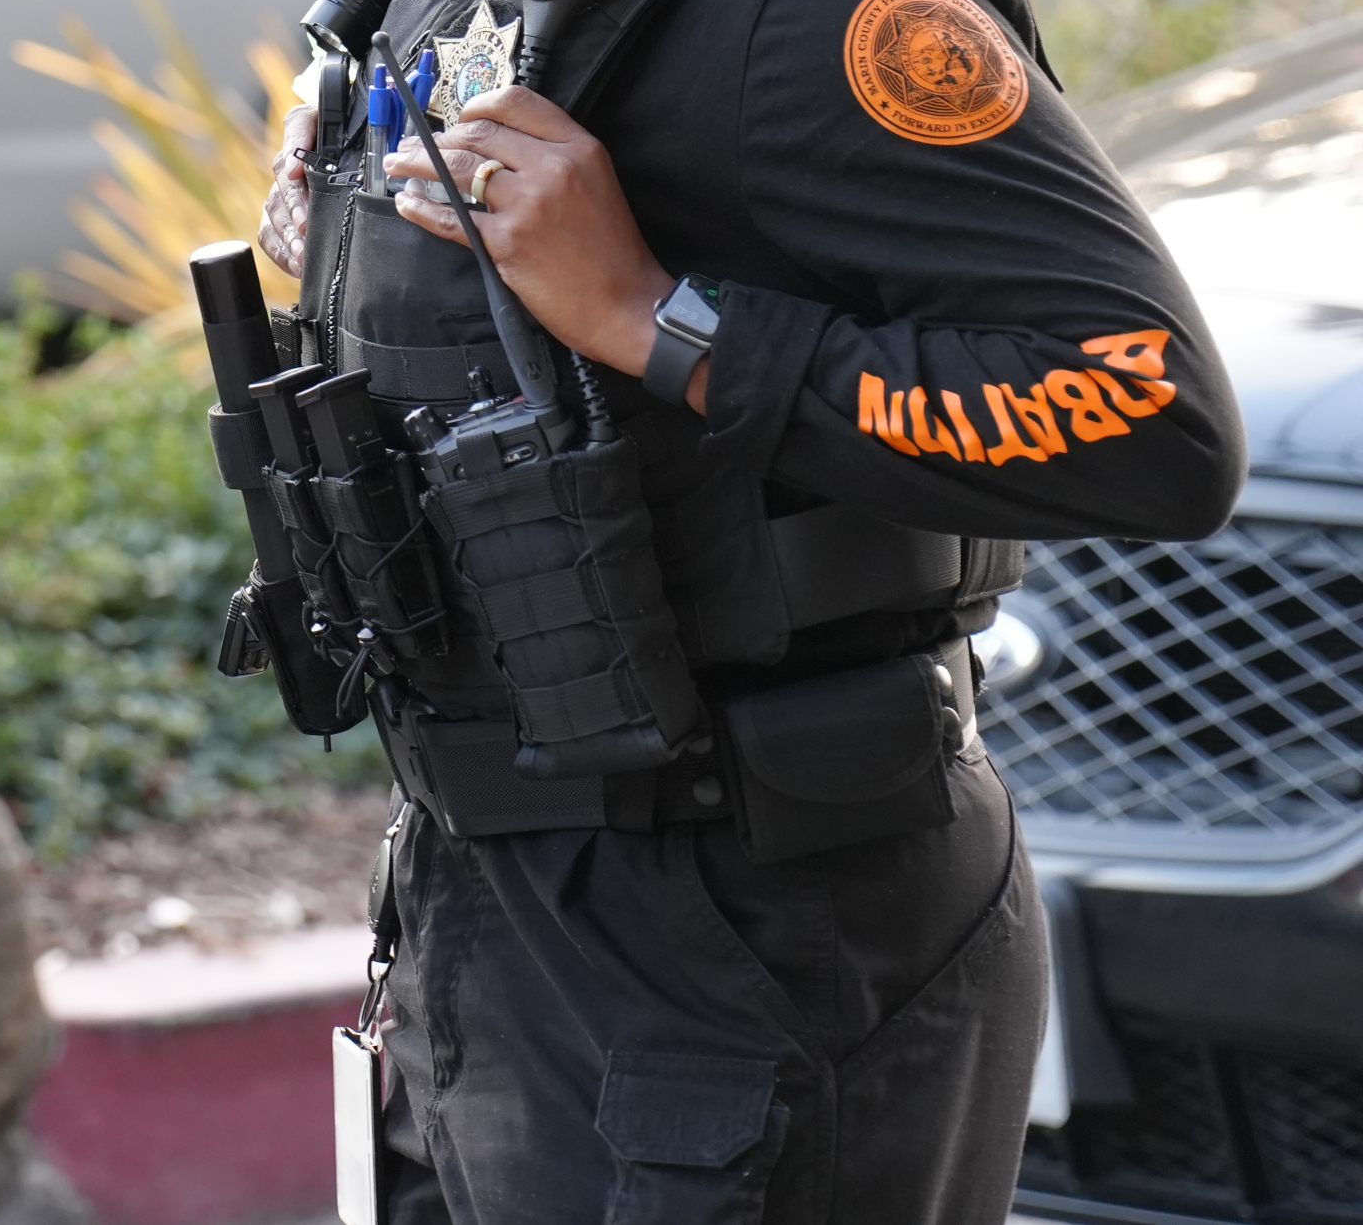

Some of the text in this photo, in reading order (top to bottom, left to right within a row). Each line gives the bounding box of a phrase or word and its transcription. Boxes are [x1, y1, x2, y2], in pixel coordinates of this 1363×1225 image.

[858, 5, 881, 52] COUNTY
[857, 55, 880, 96] MARIN
[891, 83, 1019, 134] FORWARD IN EXCELLENCE
